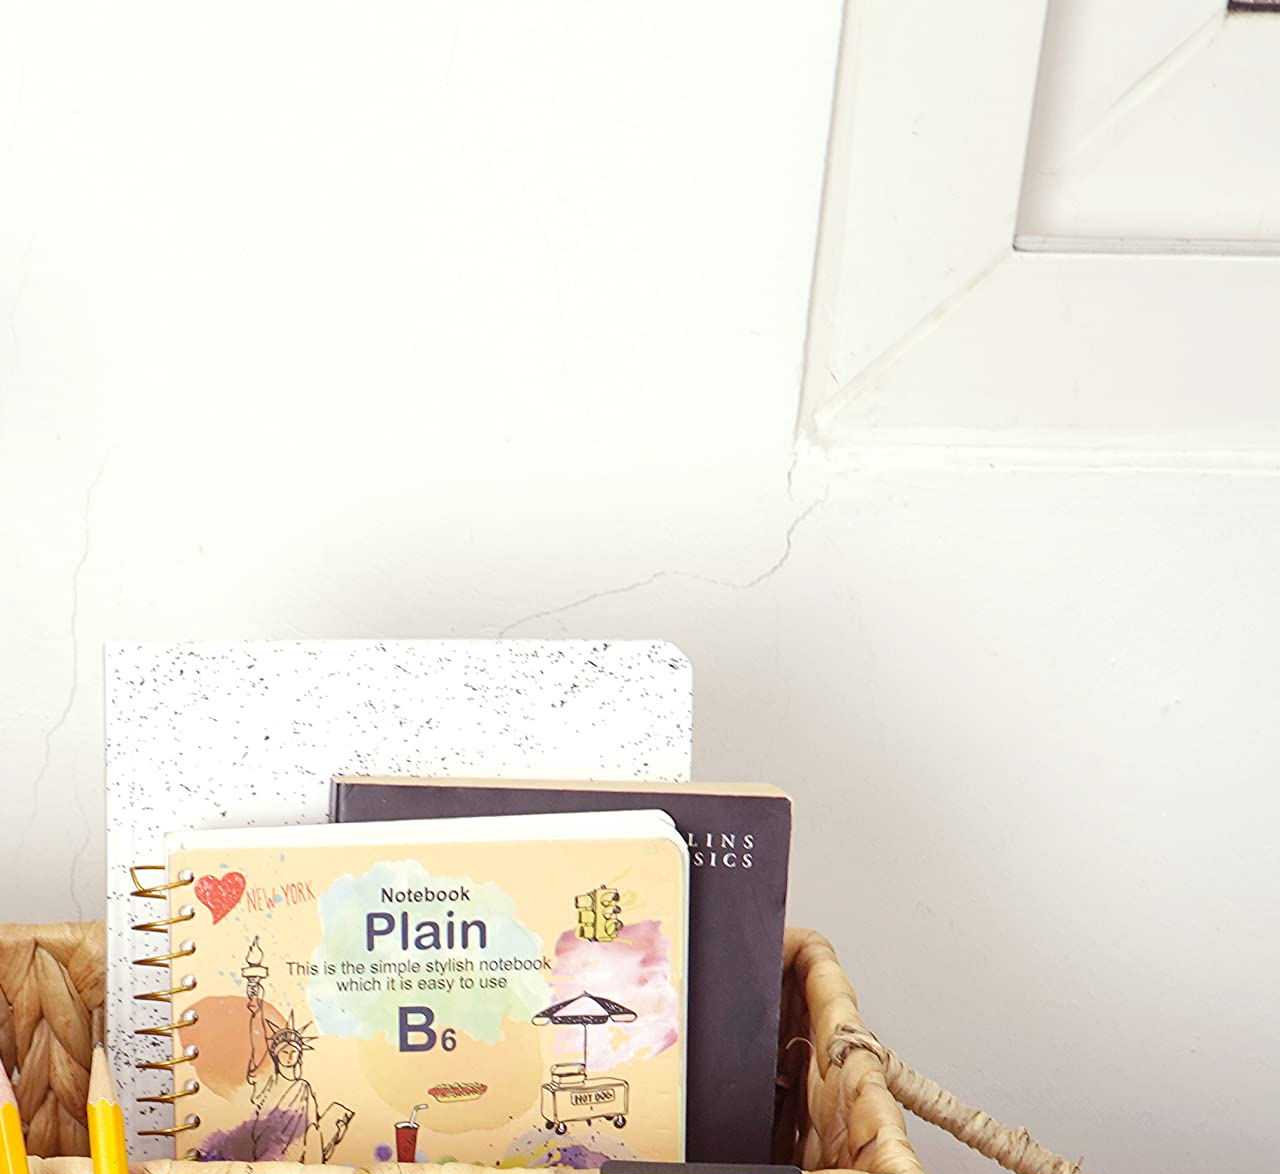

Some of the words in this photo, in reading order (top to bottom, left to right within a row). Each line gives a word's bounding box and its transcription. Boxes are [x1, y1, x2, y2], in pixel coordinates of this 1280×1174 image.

[687, 832, 754, 850] LINS
[693, 851, 753, 869] SICS
[246, 887, 276, 912] NEW
[280, 880, 316, 906] YORK
[380, 886, 470, 903] Notebook
[366, 910, 487, 952] Plain
[286, 961, 319, 976] This
[324, 961, 336, 975] is
[341, 960, 365, 975] the
[370, 959, 420, 978] simple
[425, 957, 474, 976] stylish
[479, 956, 552, 972] notebook
[336, 976, 381, 992] which
[386, 976, 396, 991] it
[400, 976, 412, 990] is
[417, 978, 455, 993] easy
[459, 976, 474, 989] to
[479, 976, 508, 989] use
[398, 1006, 457, 1052] B6
[574, 1094, 593, 1104] HOT
